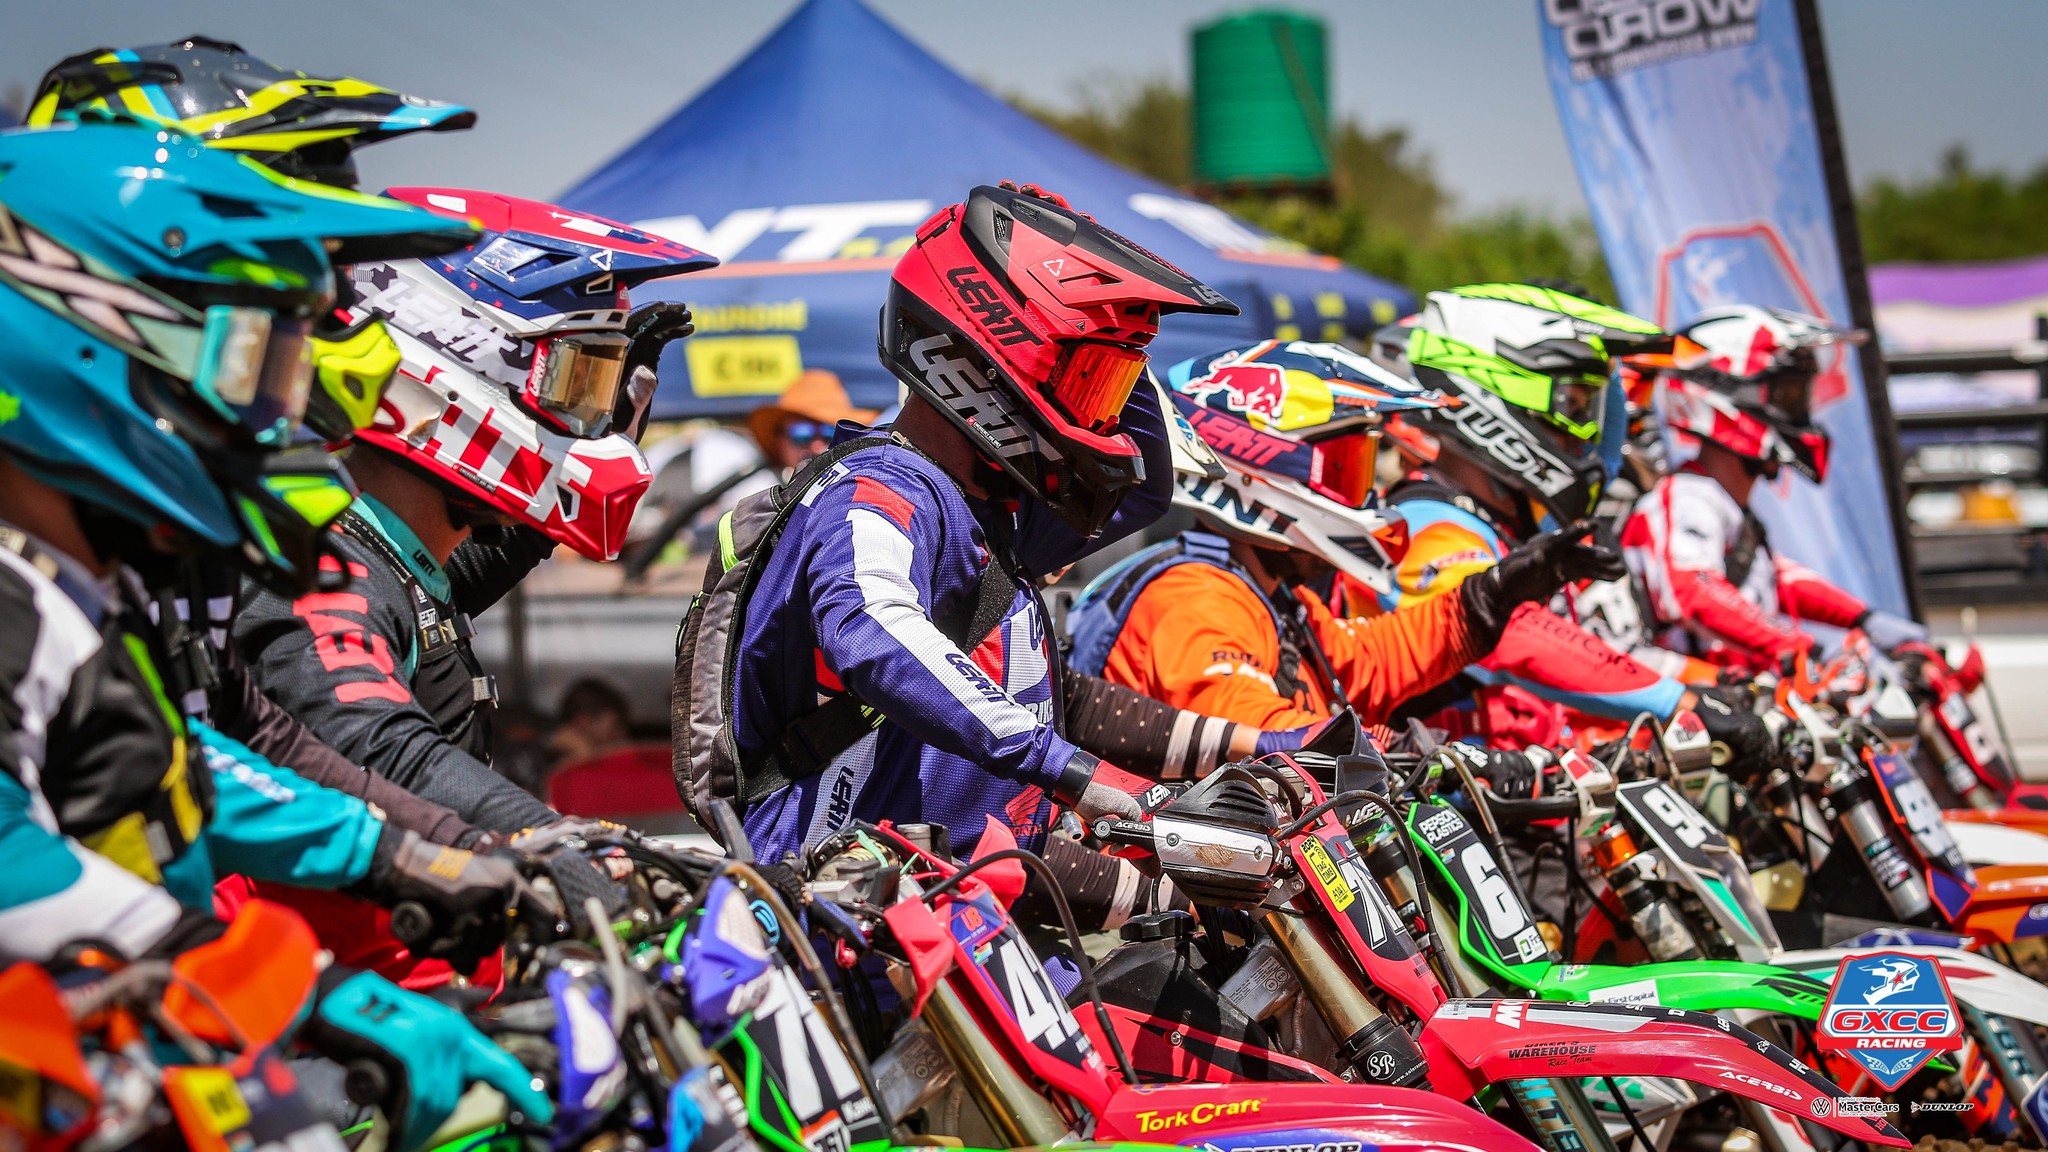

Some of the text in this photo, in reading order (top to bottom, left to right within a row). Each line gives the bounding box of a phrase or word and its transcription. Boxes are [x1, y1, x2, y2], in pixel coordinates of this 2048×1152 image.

[946, 266, 1044, 346] LEATT
[528, 347, 548, 397] LEATT
[909, 334, 1064, 461] LEATT
[945, 652, 1014, 705] LEATT
[827, 765, 855, 831] LEATT
[1418, 808, 1458, 834] PEPSON
[1426, 819, 1464, 844] PLASTICS
[1301, 835, 1317, 853] 2024
[1317, 861, 1328, 872] TAG
[1322, 867, 1335, 880] TIME
[1460, 841, 1525, 940] 6
[1628, 991, 1655, 1002] Capital
[1508, 1045, 1596, 1059] WAREHOUSE
[1548, 1054, 1592, 1067] Race Team
[1718, 1071, 1802, 1100] ACERBIS
